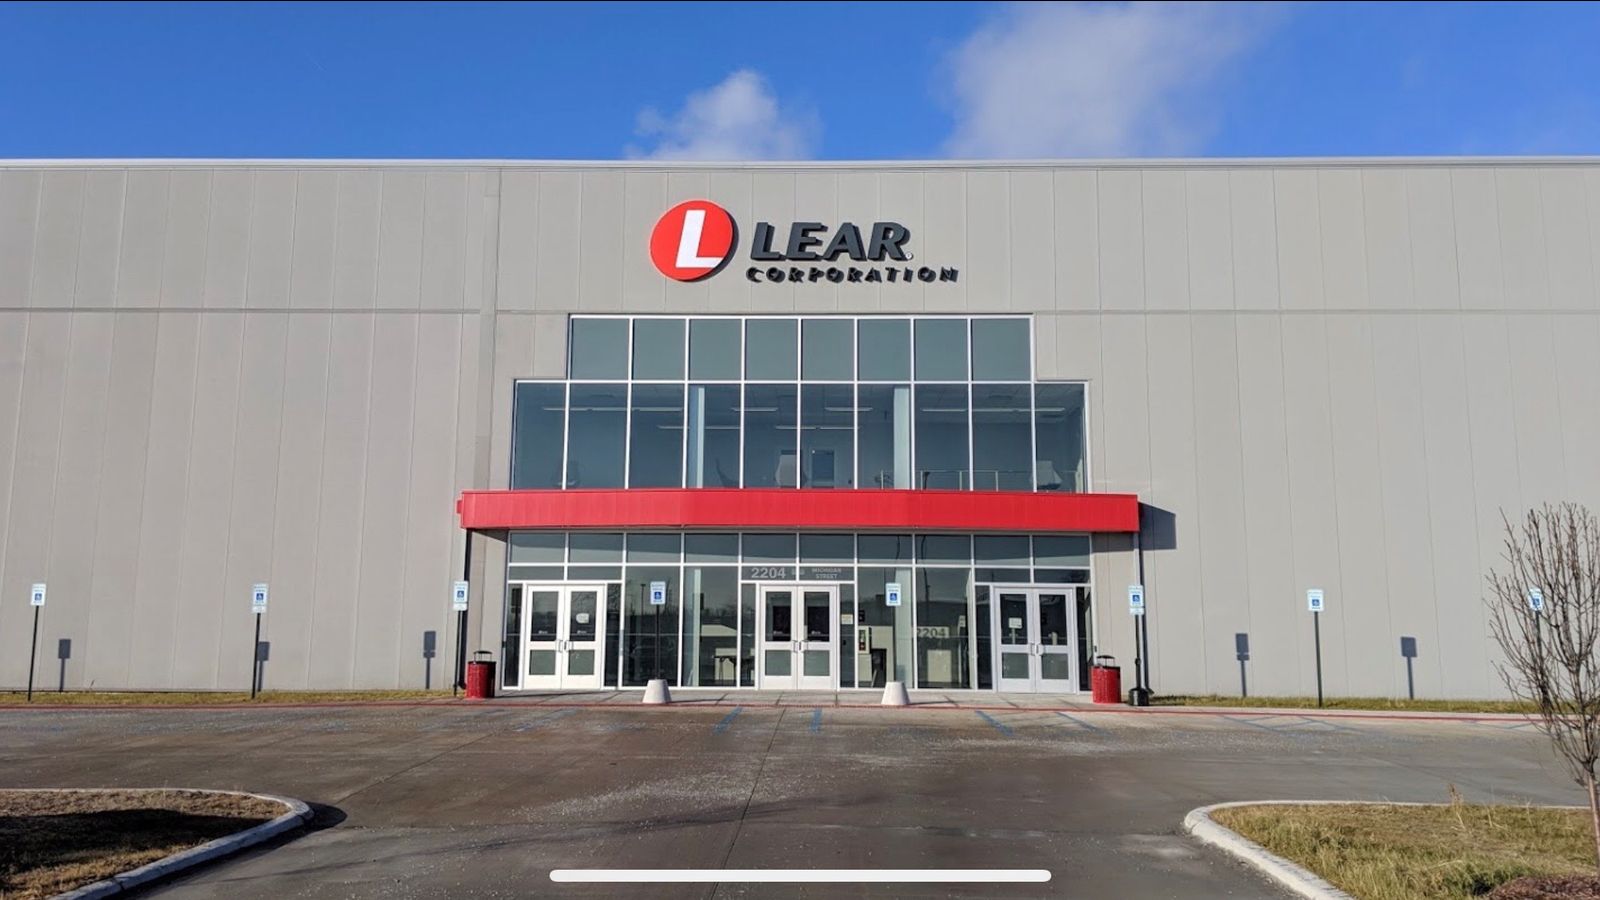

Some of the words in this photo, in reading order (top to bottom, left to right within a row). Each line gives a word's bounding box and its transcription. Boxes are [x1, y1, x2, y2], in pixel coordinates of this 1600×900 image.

[675, 209, 723, 268] L
[750, 222, 910, 260] LEAR
[746, 267, 959, 283] CORPORATION
[751, 567, 786, 579] 2204
